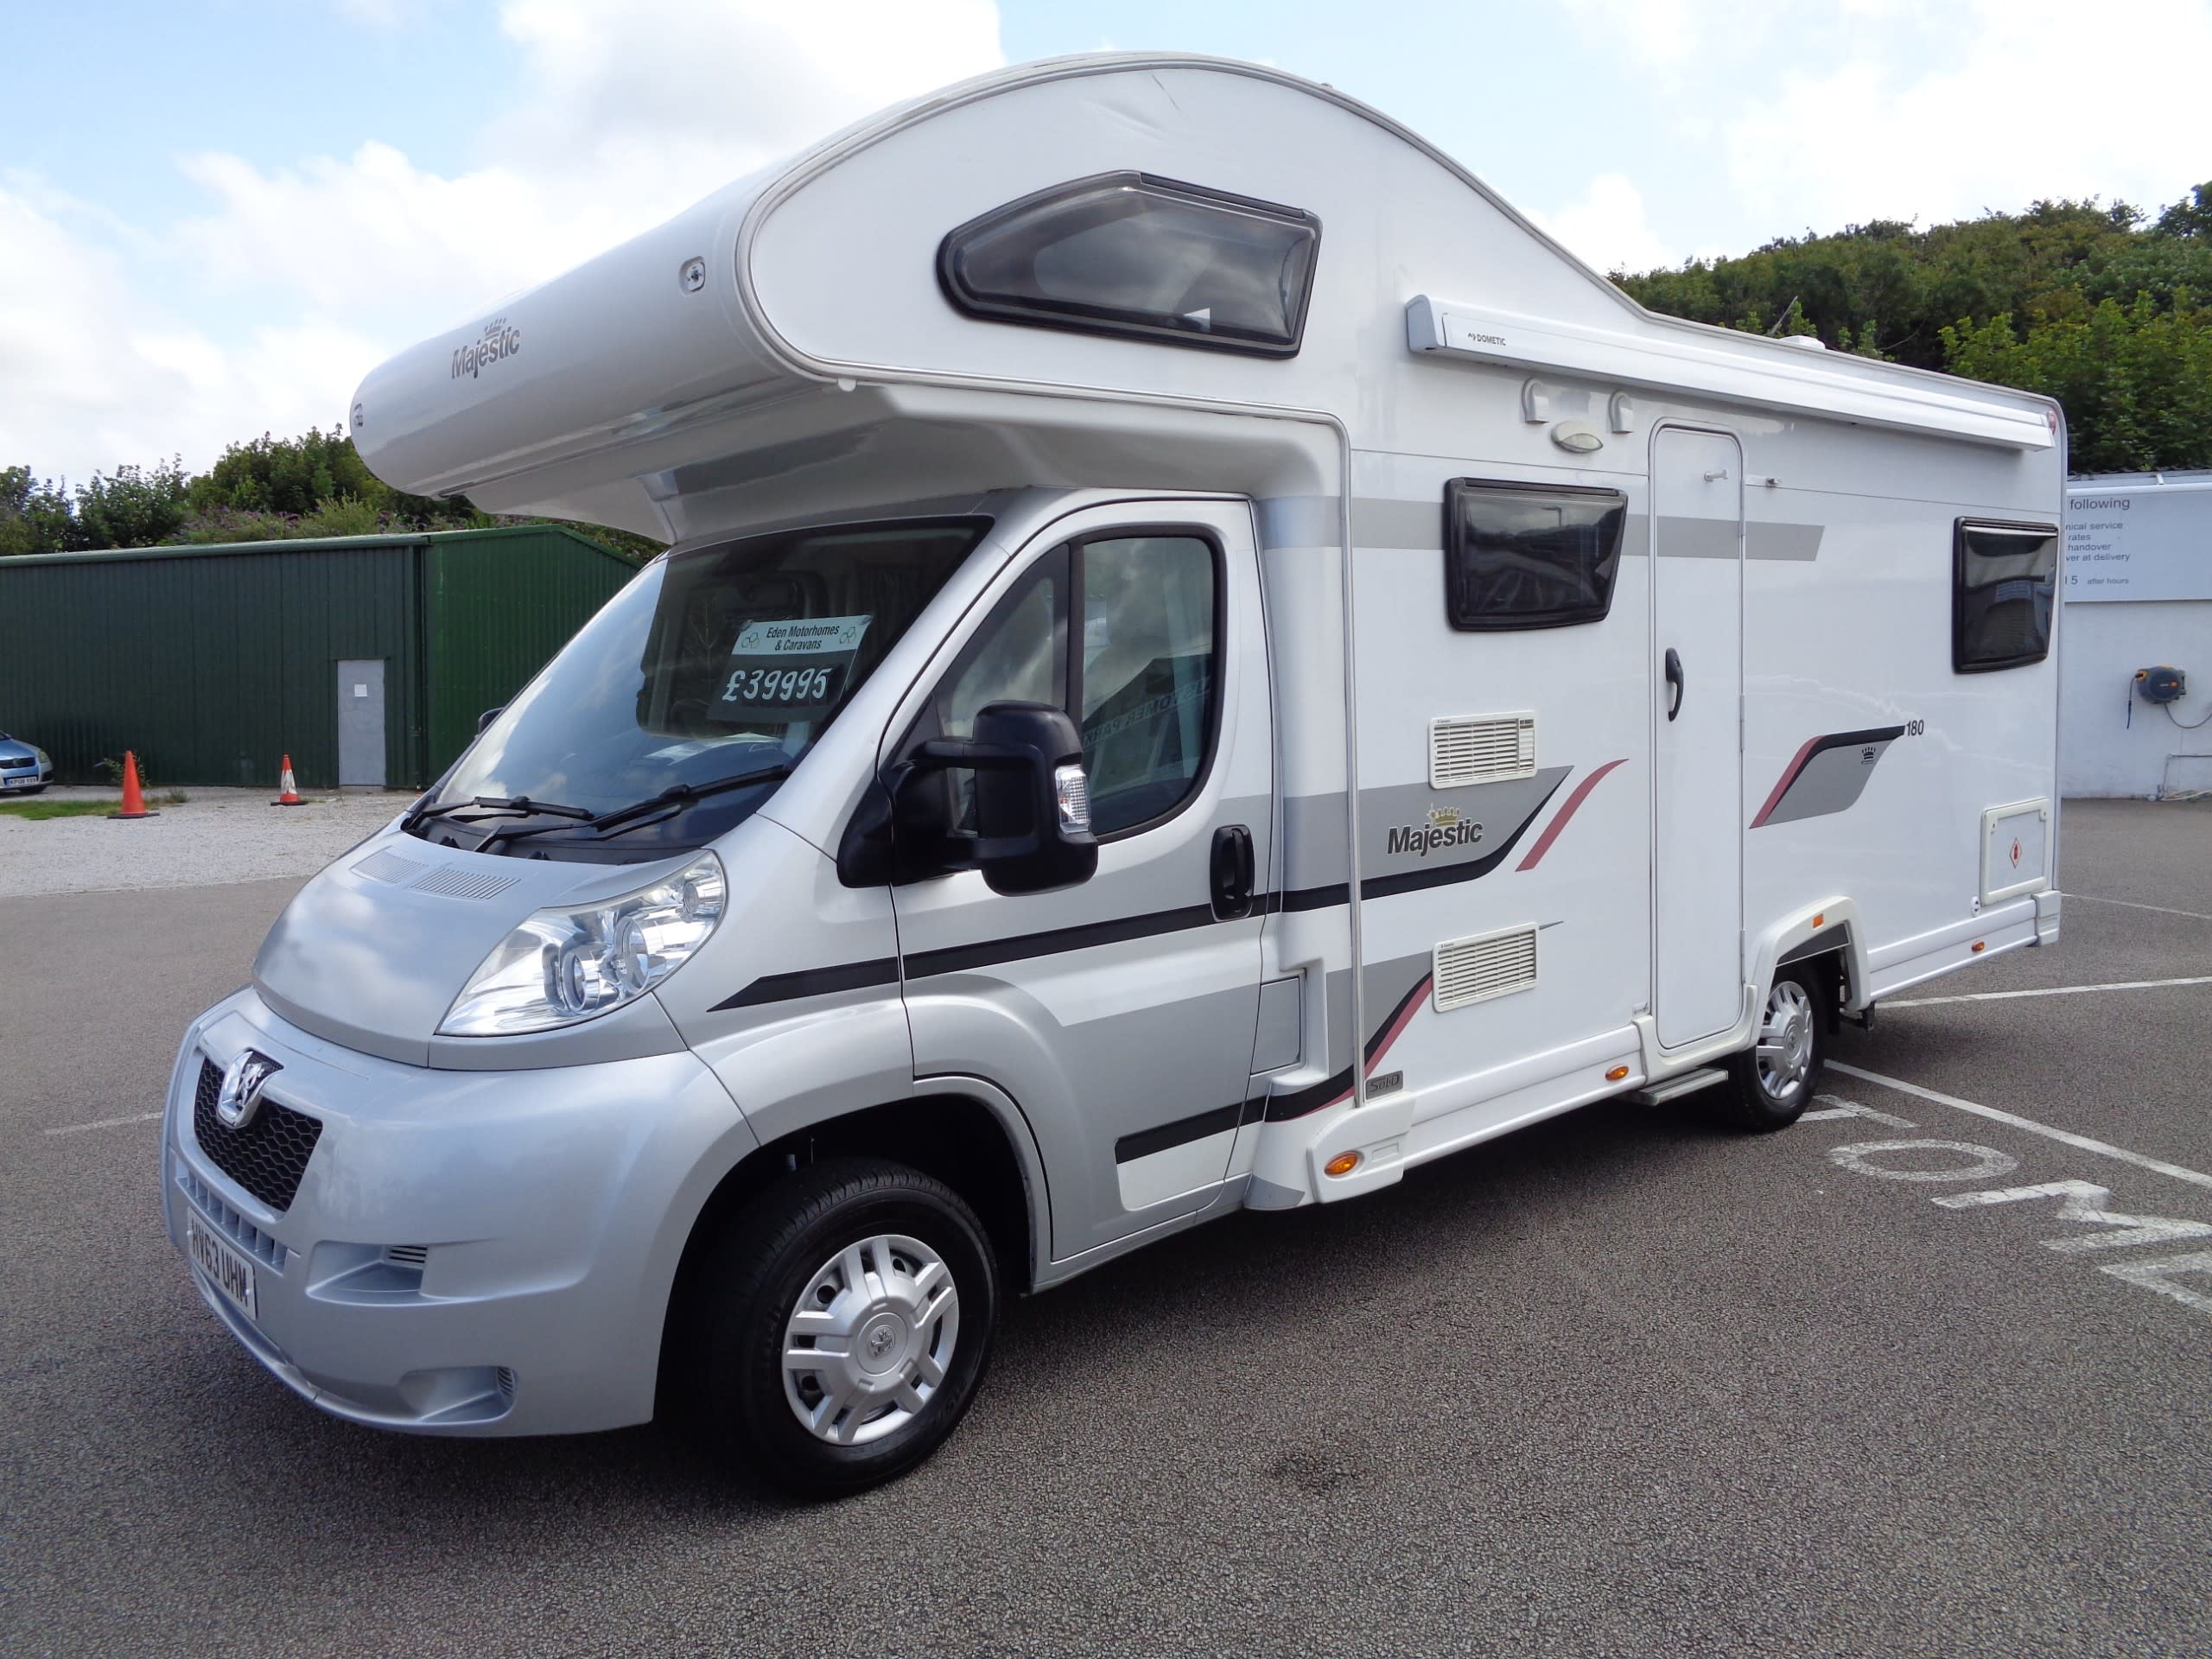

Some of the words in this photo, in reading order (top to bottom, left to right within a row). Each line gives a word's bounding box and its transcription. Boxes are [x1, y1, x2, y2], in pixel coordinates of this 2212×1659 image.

[1477, 334, 1506, 346] DOMETIC
[451, 326, 520, 379] Majestic
[2070, 498, 2131, 511] following
[2089, 522, 2123, 531] service
[2068, 533, 2091, 542] rates
[2068, 543, 2112, 551] handover
[2094, 553, 2131, 563] delivery
[766, 626, 787, 639] Eden
[788, 625, 841, 639] Motorhomes
[774, 641, 782, 652] &
[783, 639, 823, 651] Caravans
[721, 668, 833, 702] £39995
[1907, 719, 1924, 736] 180
[1387, 818, 1484, 857] Majestic
